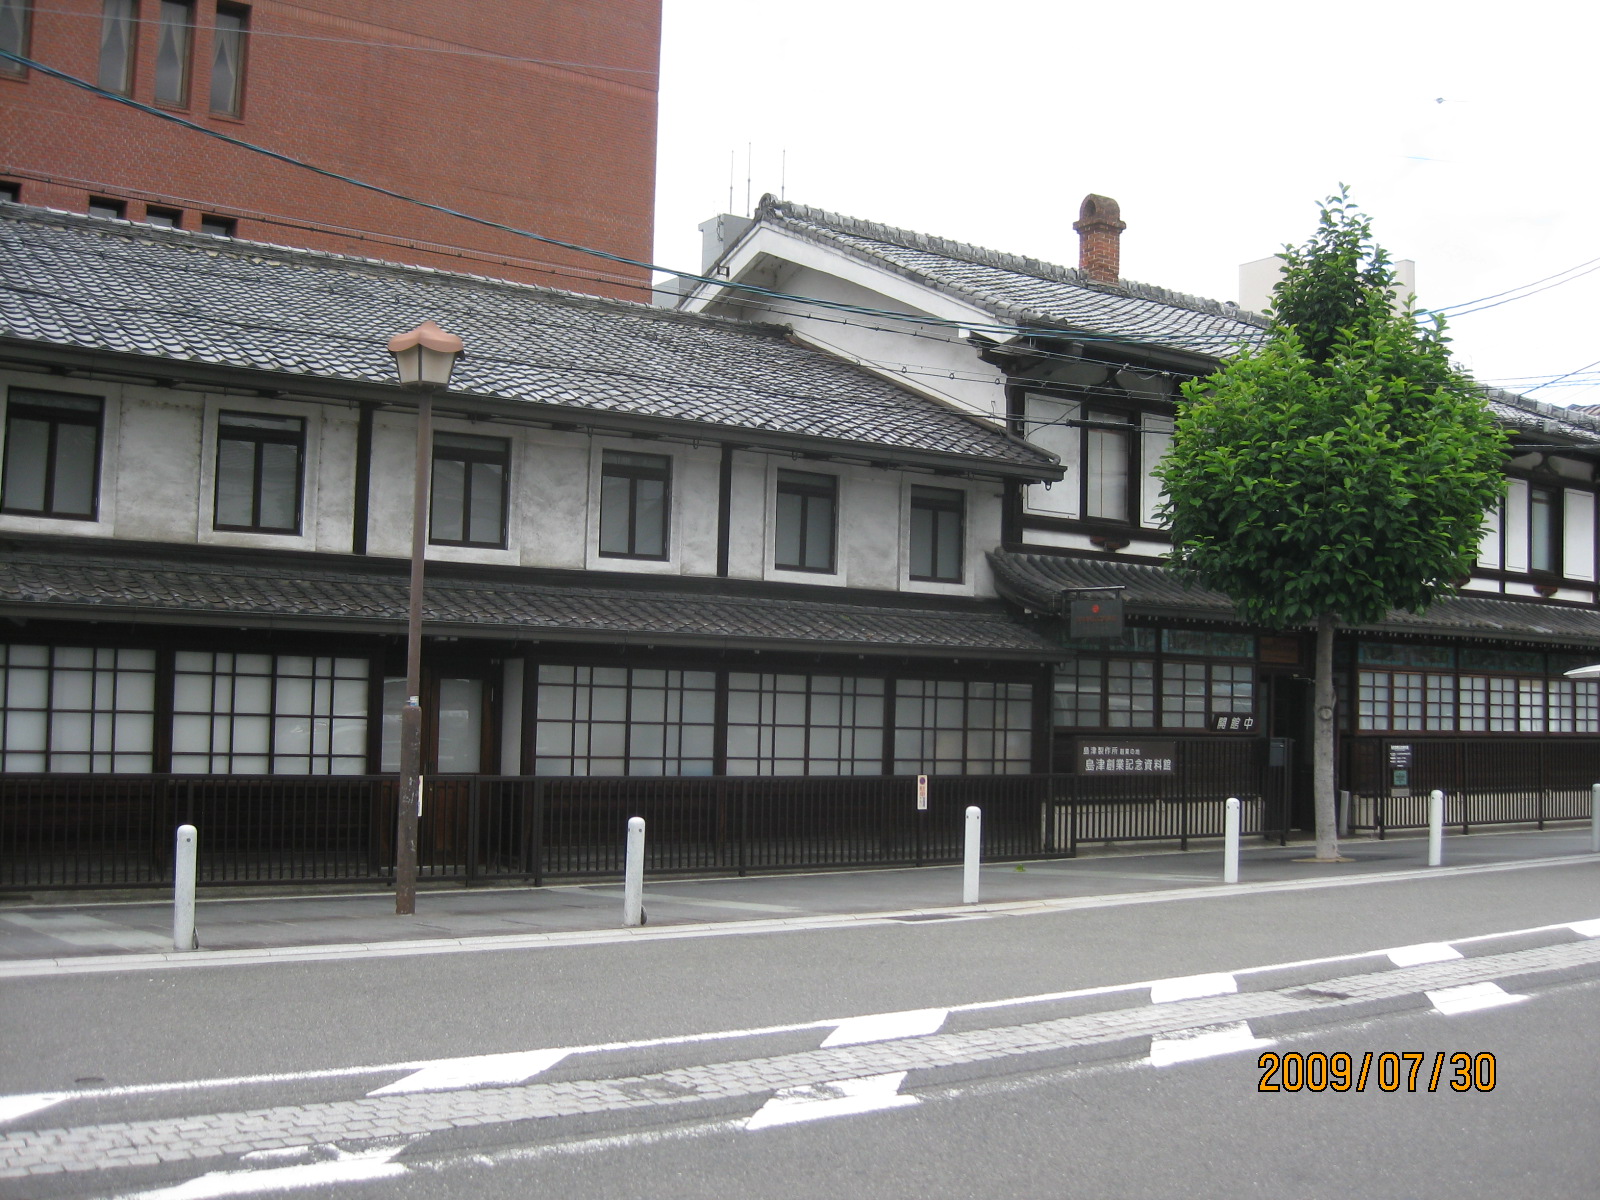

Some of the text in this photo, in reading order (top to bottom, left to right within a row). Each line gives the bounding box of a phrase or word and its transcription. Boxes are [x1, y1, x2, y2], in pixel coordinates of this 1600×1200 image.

[1217, 716, 1254, 730] 開館中
[1083, 746, 1118, 755] 島津製作所
[1085, 758, 1172, 771] 島津創業記念資料館
